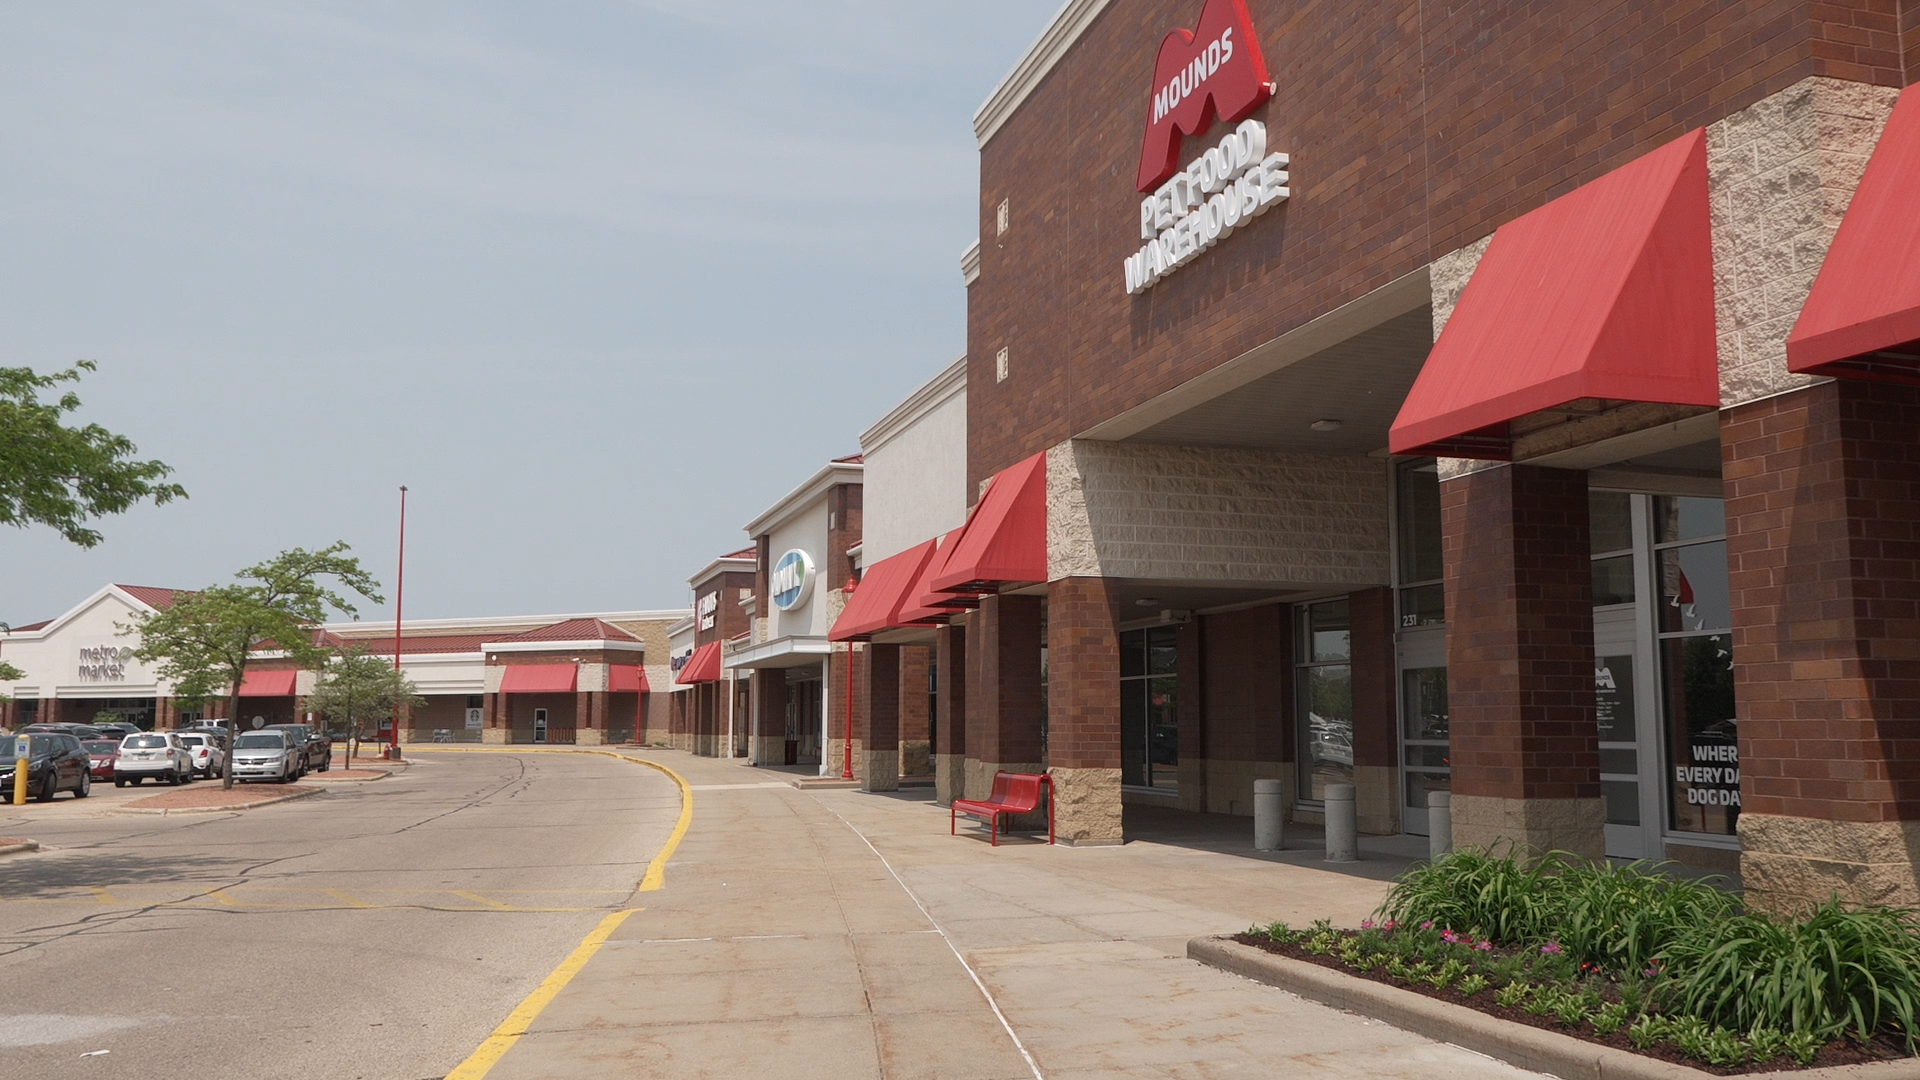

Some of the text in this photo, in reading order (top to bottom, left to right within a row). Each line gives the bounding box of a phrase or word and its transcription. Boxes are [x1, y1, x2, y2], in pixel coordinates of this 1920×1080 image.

[1153, 26, 1233, 125] MOUNDS
[1141, 118, 1267, 239] PET FOOD
[1124, 152, 1290, 295] WAREHOUSE
[1402, 614, 1417, 627] 231
[80, 644, 118, 661] metro
[79, 661, 125, 678] market
[1692, 745, 1739, 762] WHER
[1675, 766, 1723, 783] EVERY
[1687, 788, 1742, 807] DOG DA
